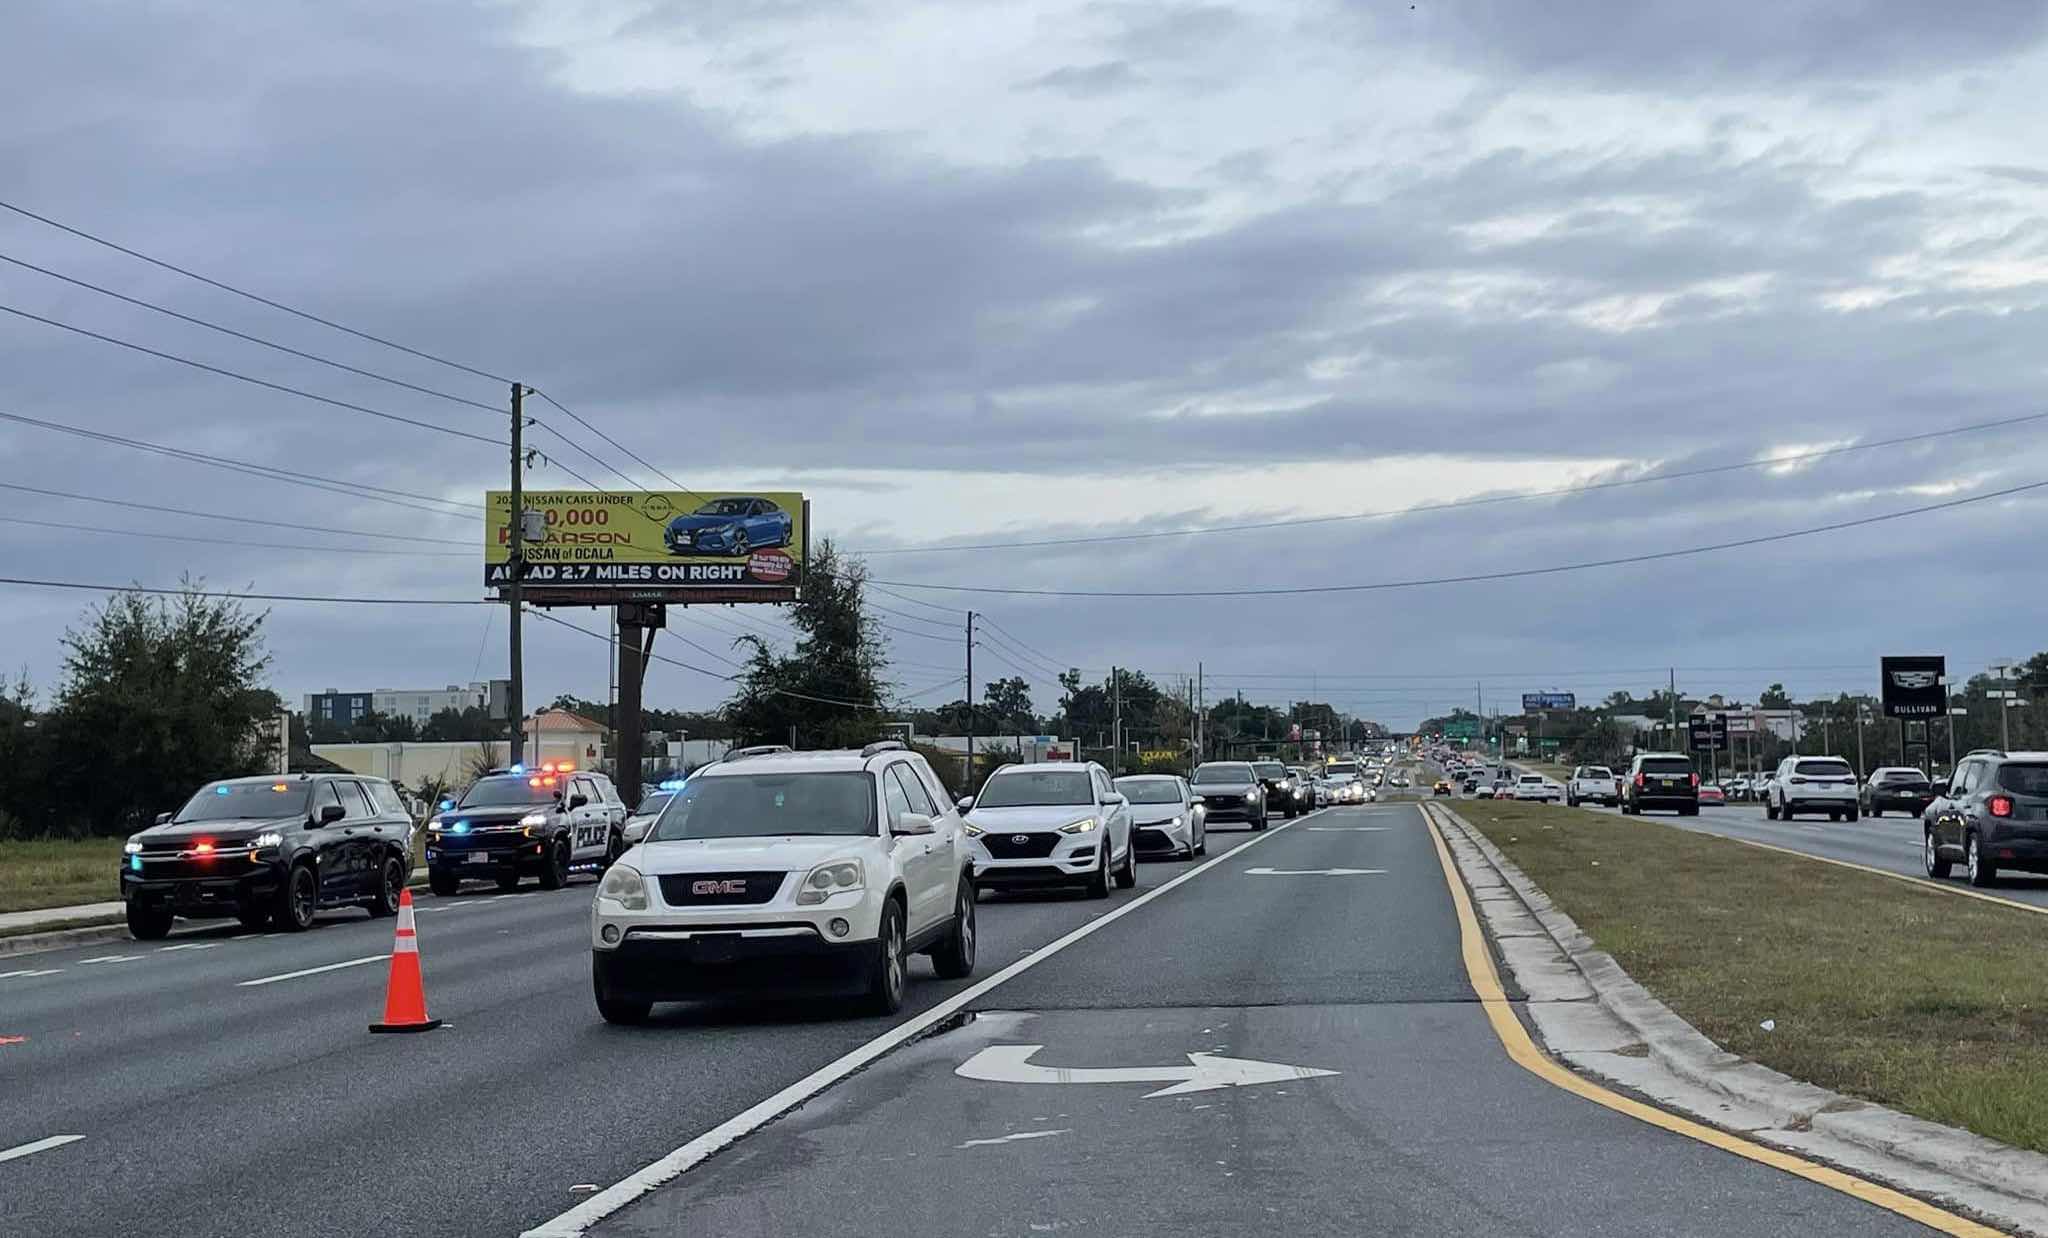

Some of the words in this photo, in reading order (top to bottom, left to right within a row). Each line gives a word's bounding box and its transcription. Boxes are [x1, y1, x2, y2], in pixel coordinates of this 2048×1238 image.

[523, 495, 563, 505] NISSAN
[566, 495, 593, 505] CARS
[597, 495, 633, 505] UNDER
[499, 527, 630, 544] PARSON
[519, 547, 560, 560] ISSAN
[562, 547, 572, 560] of
[575, 547, 614, 560] OCALA
[561, 565, 590, 580] 2.7
[596, 565, 650, 580] MILES
[657, 565, 685, 580] ON
[690, 565, 746, 580] RIGHT
[1894, 705, 1937, 714] SULLIVAN
[576, 822, 607, 849] POLICE
[692, 879, 746, 895] GMC
